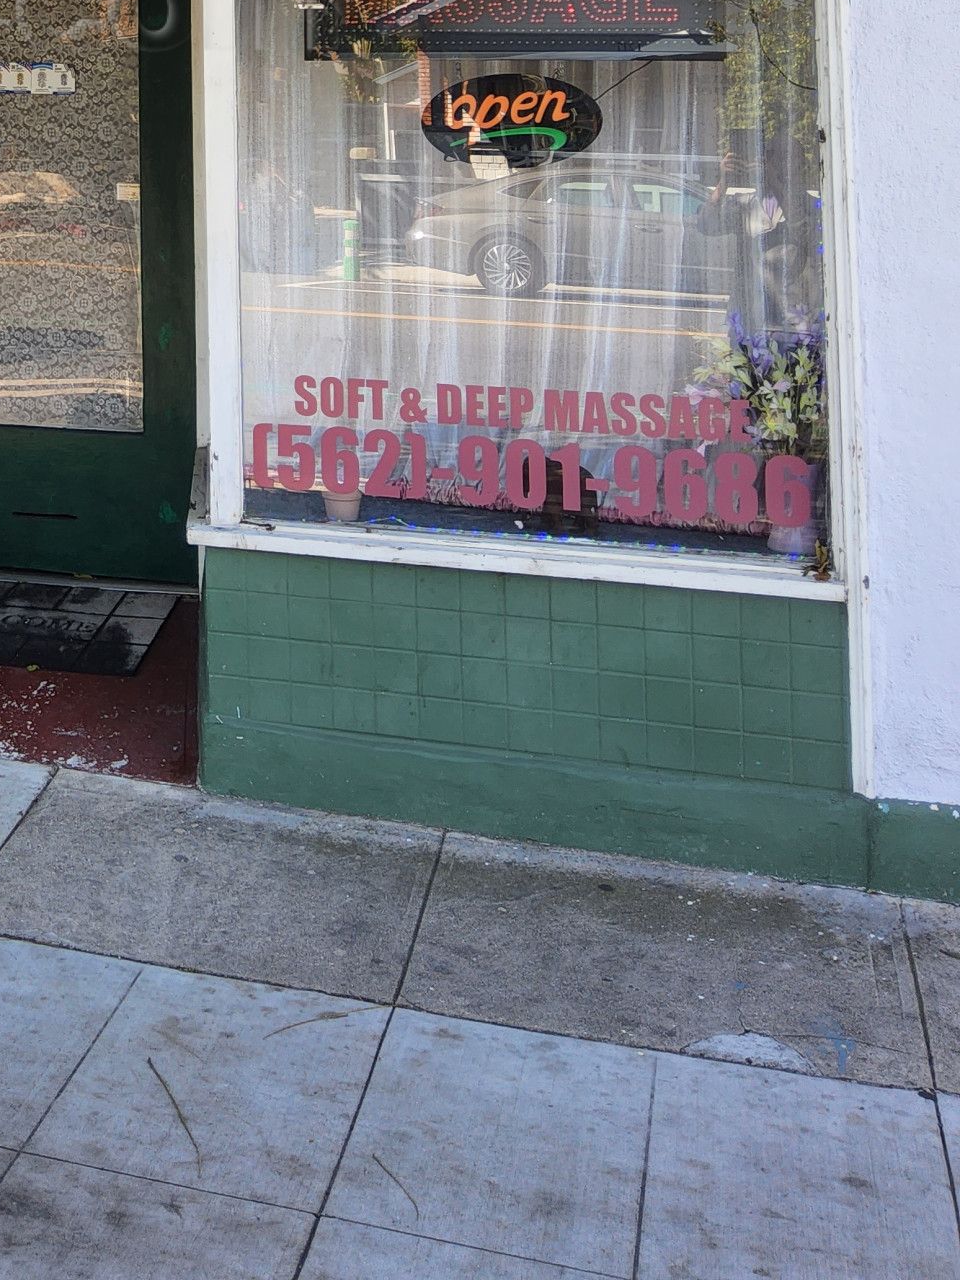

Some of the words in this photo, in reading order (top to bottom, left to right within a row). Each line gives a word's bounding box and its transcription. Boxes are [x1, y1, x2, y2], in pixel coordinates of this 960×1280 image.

[450, 89, 571, 145] open
[293, 374, 389, 420] SOFT
[399, 388, 428, 423] &
[436, 383, 534, 430] DEEP
[544, 389, 753, 443] MASSAGE
[251, 423, 812, 529] (562)-901-9686
